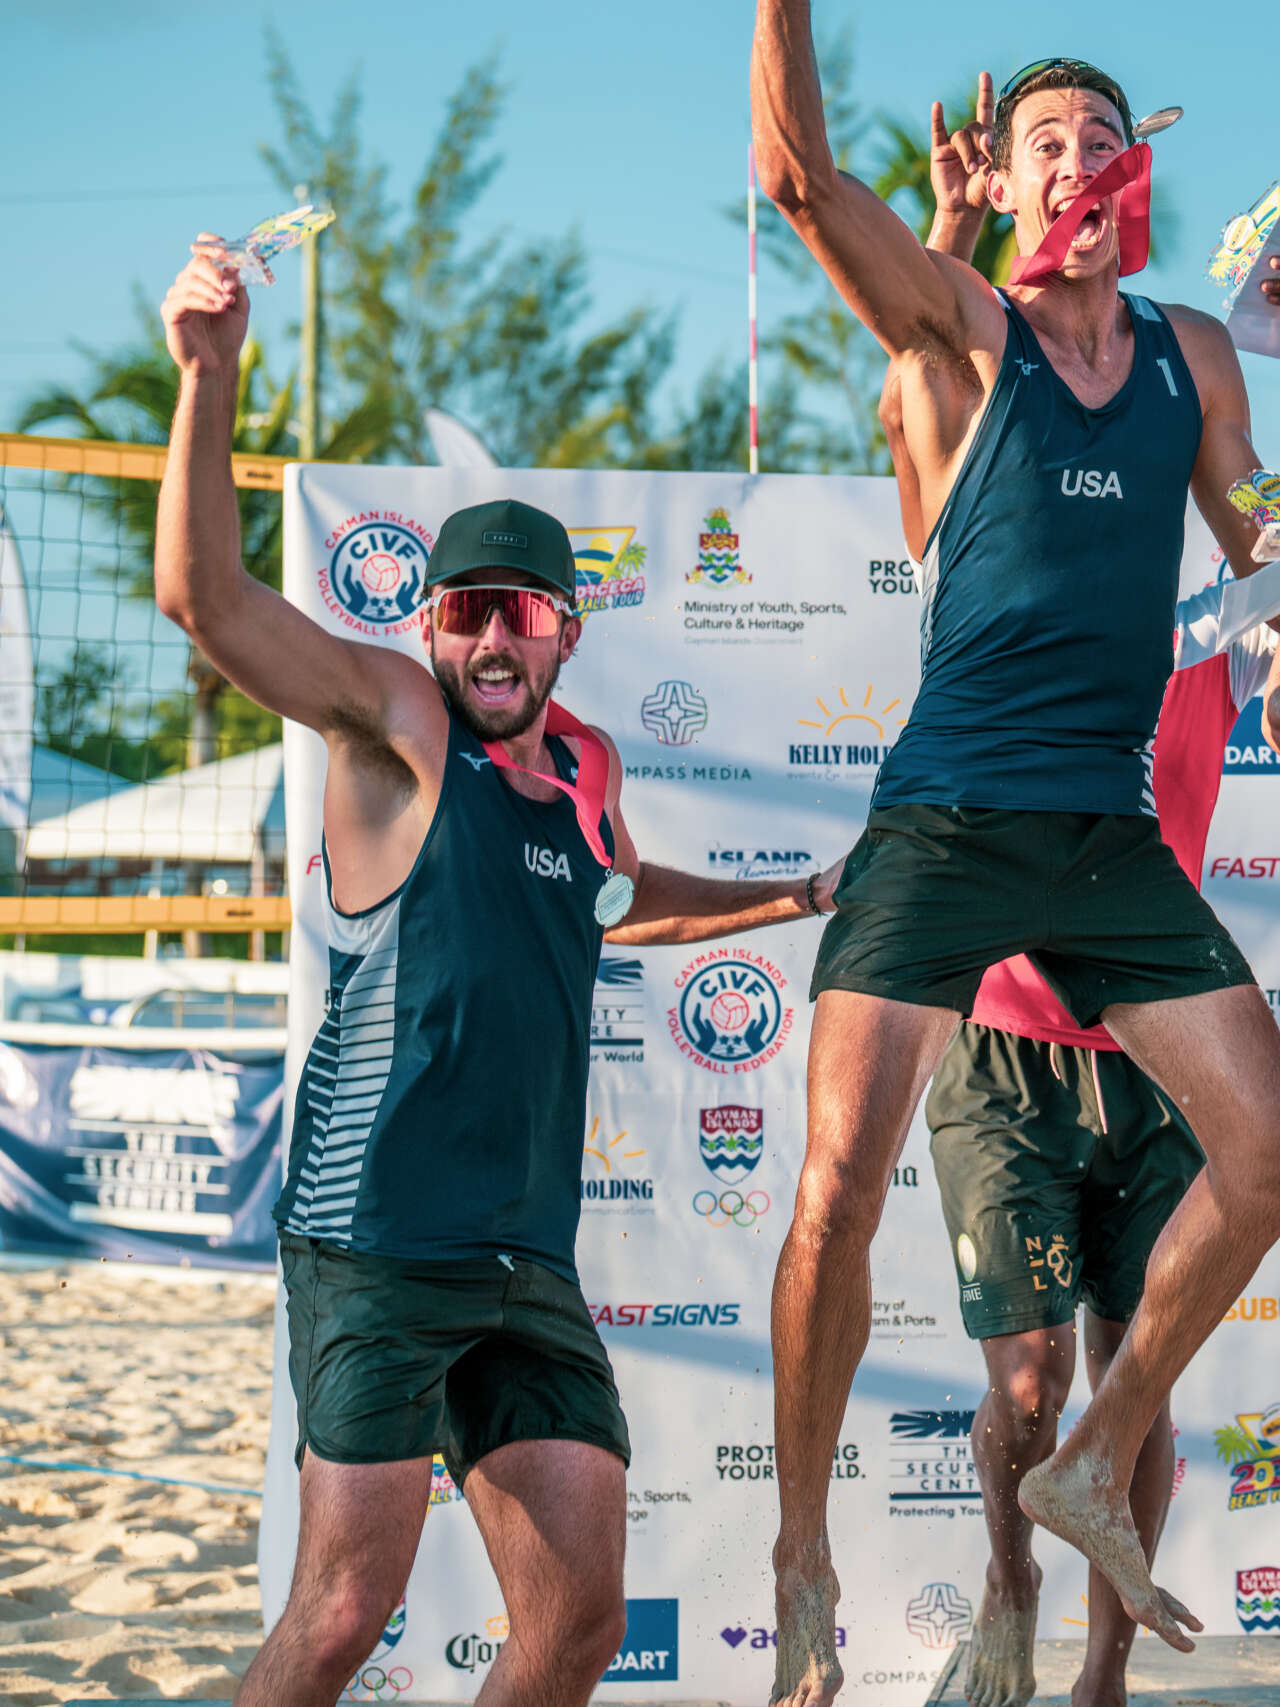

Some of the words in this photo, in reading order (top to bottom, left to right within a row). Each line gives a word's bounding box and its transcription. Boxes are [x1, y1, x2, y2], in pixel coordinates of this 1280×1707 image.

[1061, 469, 1123, 499] USA
[325, 511, 380, 549] CAYMAN
[350, 532, 417, 560] CIVF
[576, 574, 645, 600] ORCECA
[317, 567, 380, 636] VOLLEYBALL
[684, 600, 737, 616] Ministry
[741, 600, 754, 614] of
[759, 601, 797, 616] Youth,
[800, 602, 846, 616] Sports,
[684, 617, 732, 631] Culture
[735, 618, 745, 631] &
[748, 617, 804, 633] Heritage
[788, 744, 841, 766] KELLY
[692, 766, 752, 780] MEDIA
[524, 843, 573, 882] USA
[708, 850, 811, 863] ISLAND
[674, 948, 729, 988] CAYMAN
[733, 948, 788, 989] ISLANDS
[699, 970, 765, 998] CIVF
[666, 1006, 729, 1074] VOLLEYBALL
[734, 1007, 794, 1074] FEDERATION
[604, 1050, 644, 1063] World
[705, 1109, 758, 1121] CAYMAN
[705, 1118, 759, 1130] ISLANDS
[893, 1299, 905, 1311] of
[892, 1315, 901, 1326] &
[904, 1315, 936, 1327] Ports
[716, 1464, 775, 1480] YOUR
[643, 1489, 692, 1505] Sports,
[1228, 1490, 1268, 1511] BEACH
[889, 1505, 955, 1519] Protecting
[608, 1650, 670, 1671] DART
